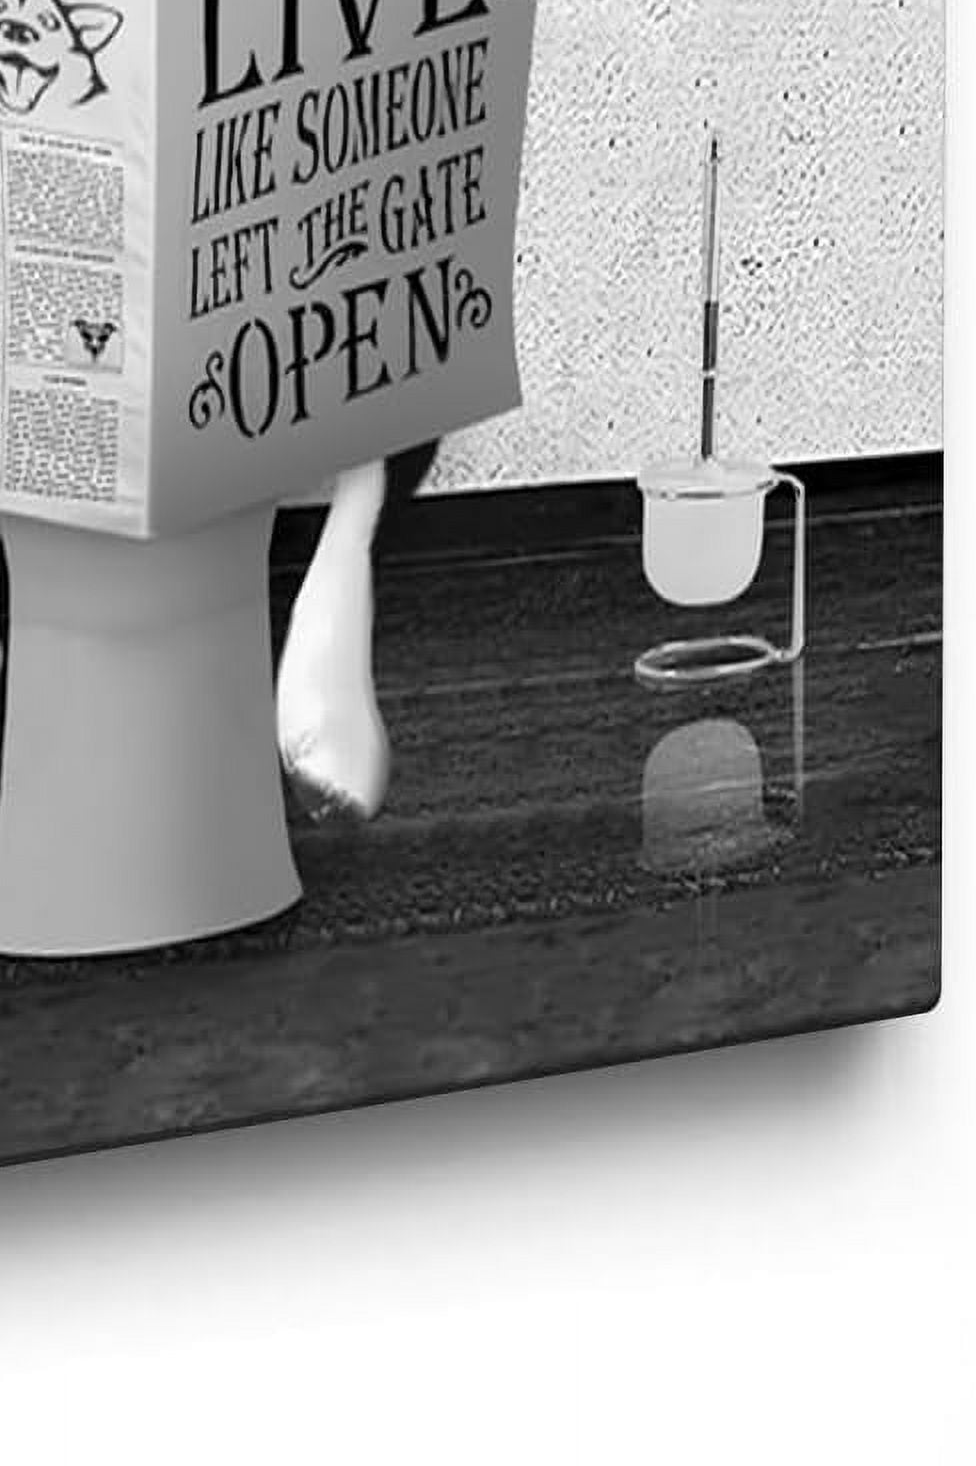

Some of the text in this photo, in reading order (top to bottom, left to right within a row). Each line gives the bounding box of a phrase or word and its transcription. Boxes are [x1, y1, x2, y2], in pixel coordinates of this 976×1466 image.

[191, 101, 281, 225] LIKE
[291, 37, 489, 185] SOMEONE
[189, 217, 278, 320] LEFT
[297, 179, 370, 269] THE
[379, 145, 486, 255] GATE
[228, 255, 455, 439] OPEN
